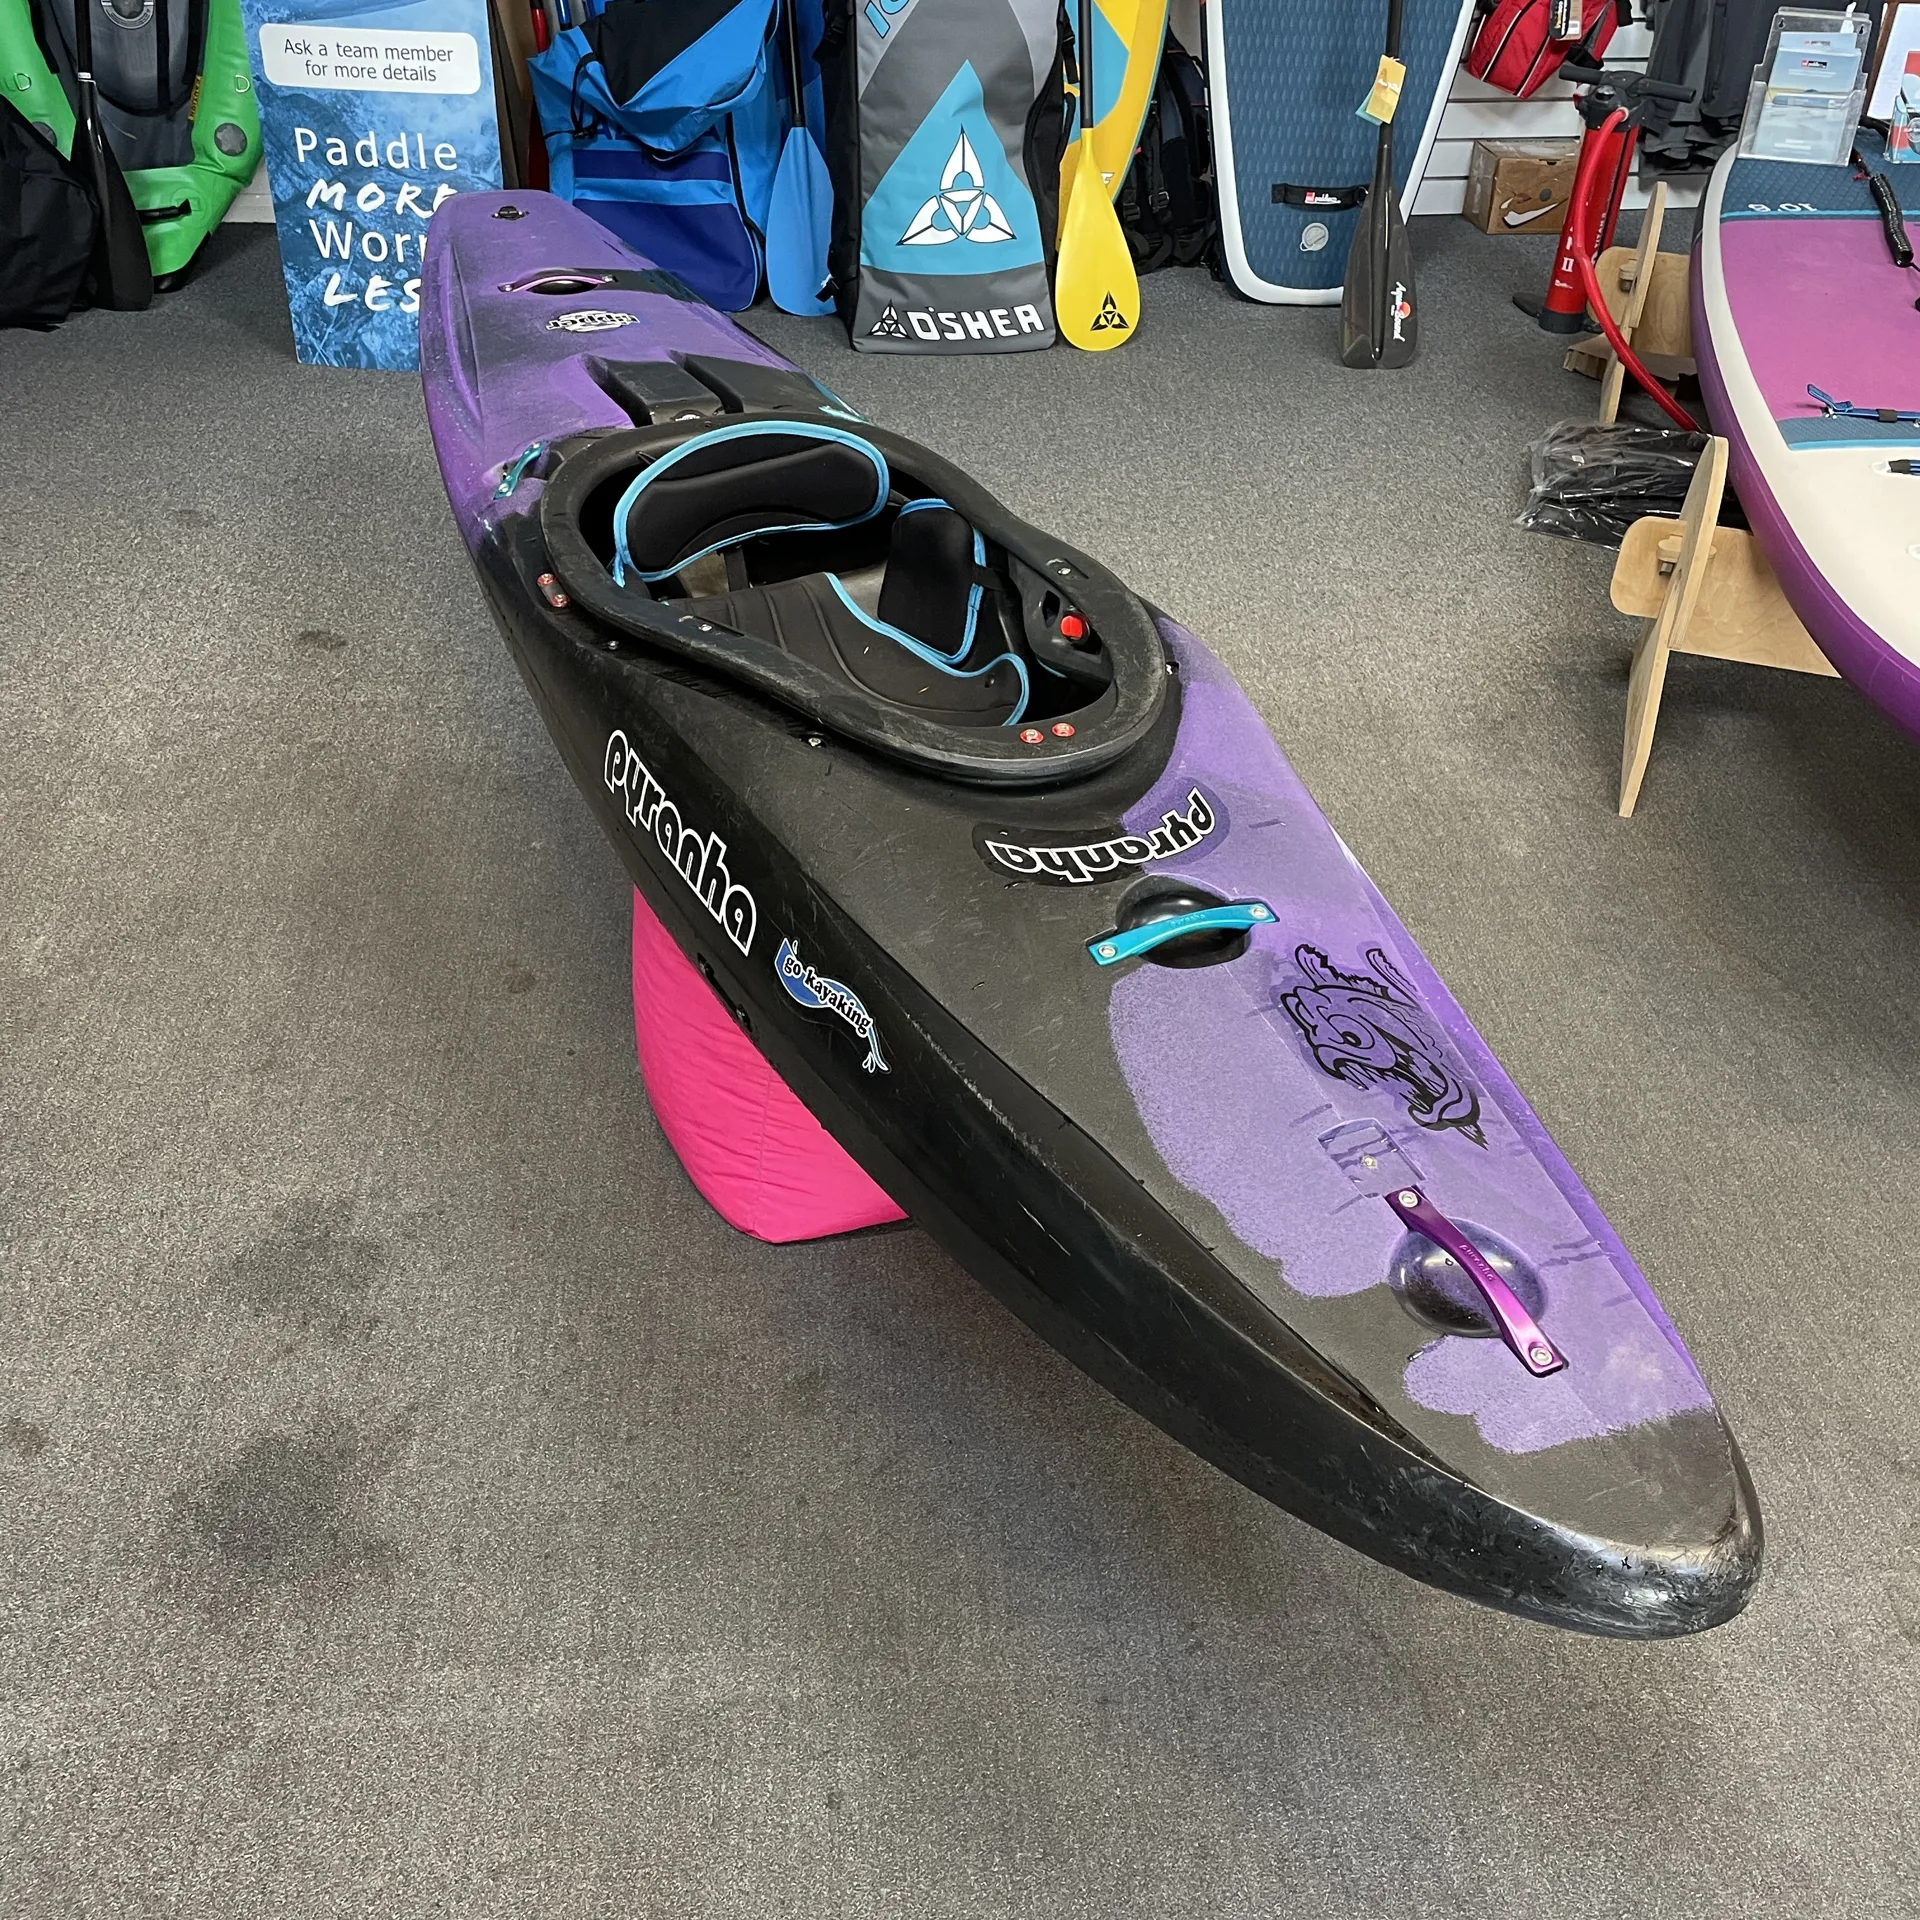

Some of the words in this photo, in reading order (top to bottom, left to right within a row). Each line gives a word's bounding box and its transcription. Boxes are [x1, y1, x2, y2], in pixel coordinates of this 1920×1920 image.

[284, 38, 313, 56] Ask
[318, 43, 328, 57] a
[336, 42, 379, 59] team
[385, 45, 454, 62] member
[305, 60, 328, 77] for
[334, 64, 377, 79] more
[382, 64, 437, 82] details
[294, 127, 458, 171] Paddle
[905, 303, 1046, 342] O'SHEA
[604, 729, 757, 957] pyranha
[984, 786, 1217, 884] pyranha
[783, 955, 802, 978] go
[804, 967, 872, 1037] kayaking
